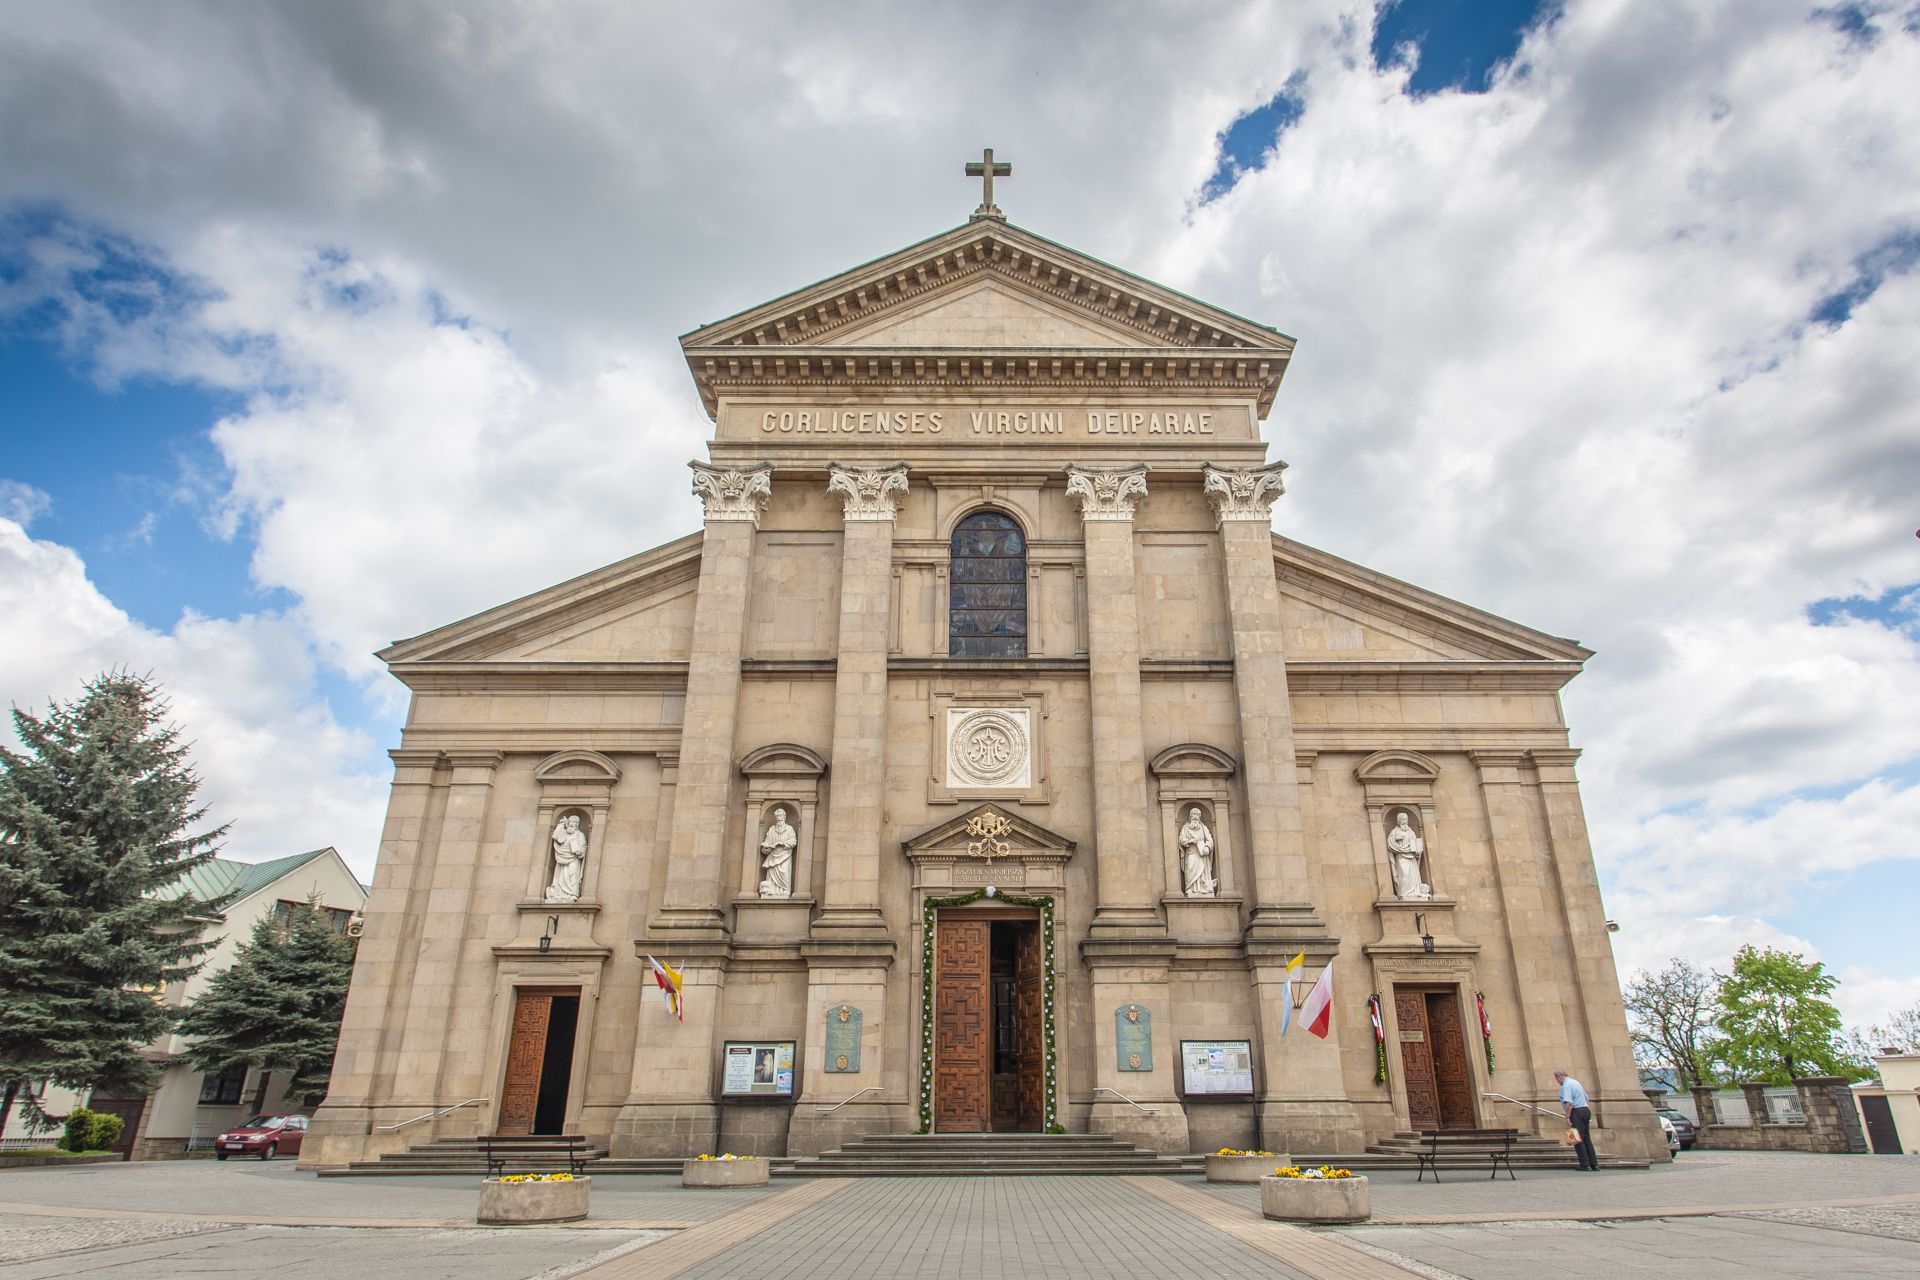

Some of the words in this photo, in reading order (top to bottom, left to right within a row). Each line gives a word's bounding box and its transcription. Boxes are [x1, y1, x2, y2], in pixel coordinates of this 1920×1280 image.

[762, 411, 943, 433] GORLICENSES
[970, 411, 1063, 433] VIRGINI
[1087, 411, 1213, 434] DEIPARAE
